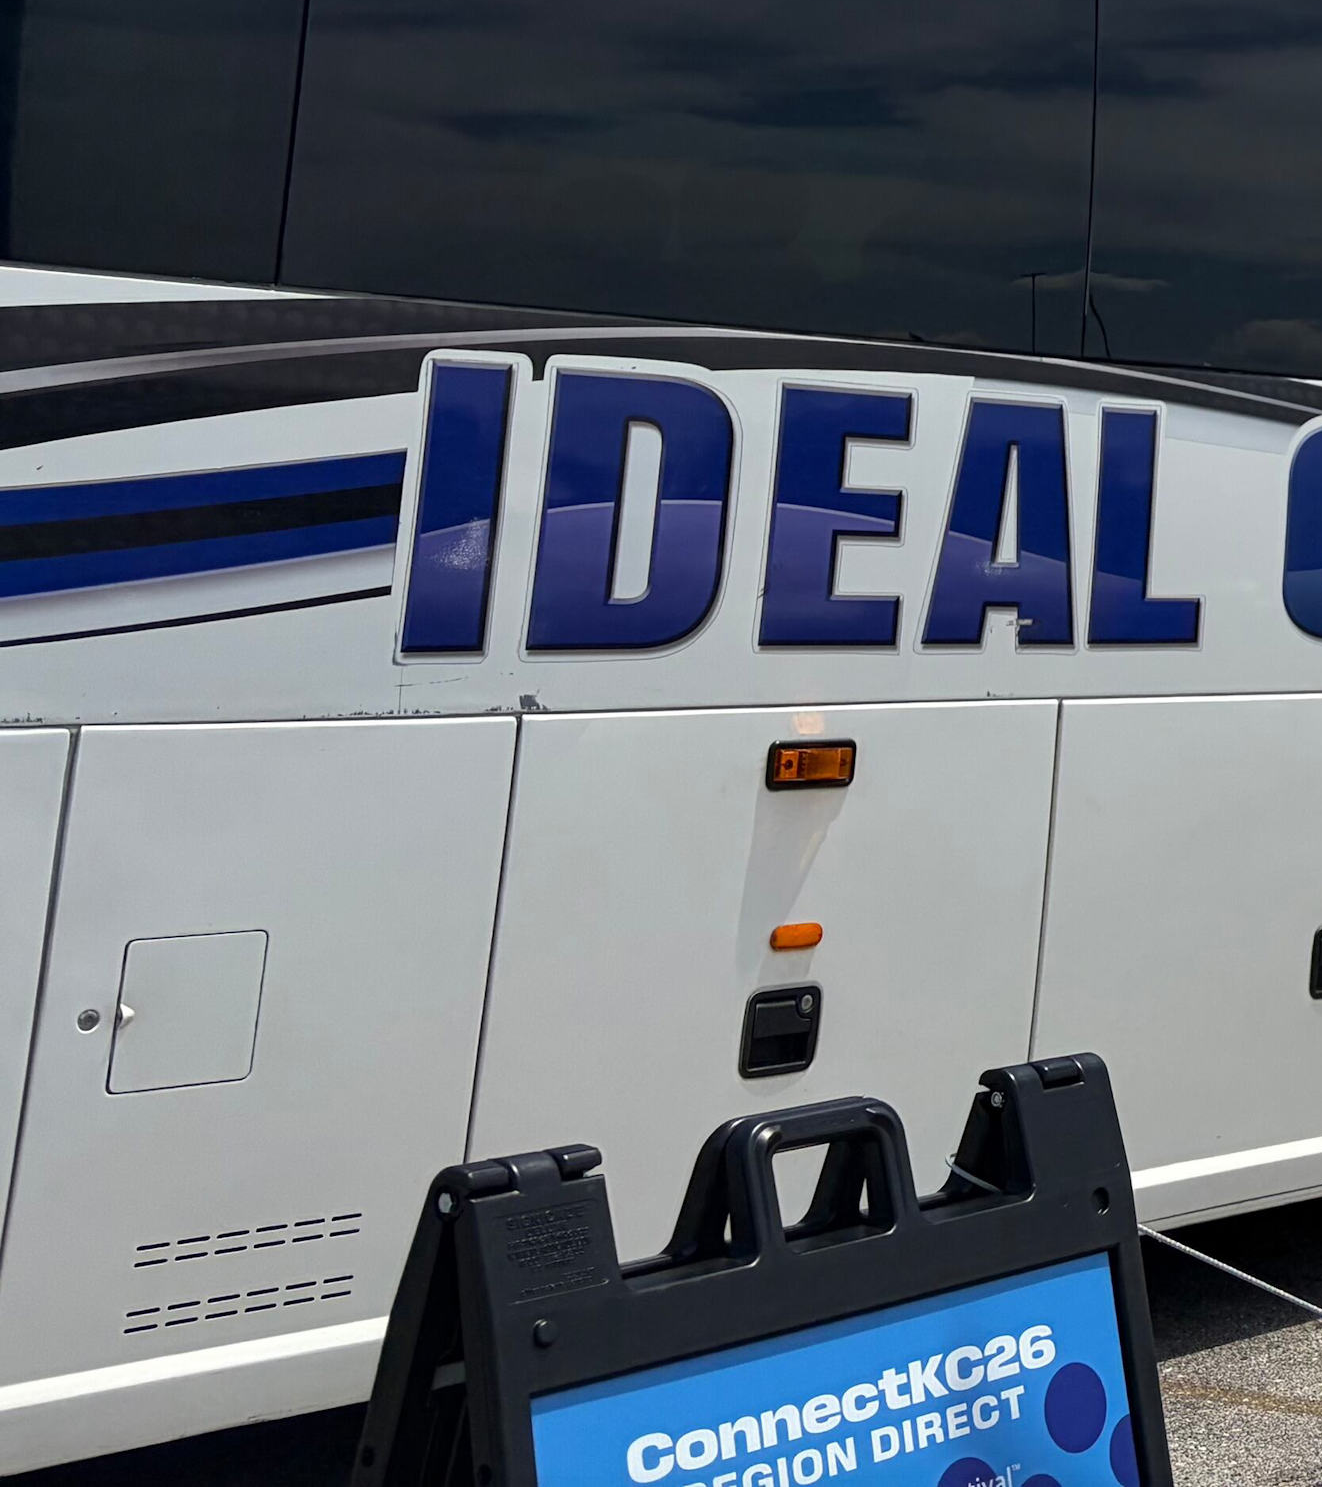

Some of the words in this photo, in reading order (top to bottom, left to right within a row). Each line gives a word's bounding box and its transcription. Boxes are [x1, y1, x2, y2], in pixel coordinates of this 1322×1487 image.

[401, 358, 1203, 654] IDEAL
[626, 1324, 1057, 1483] ConnectKC26
[872, 1386, 1025, 1465] DIRECT
